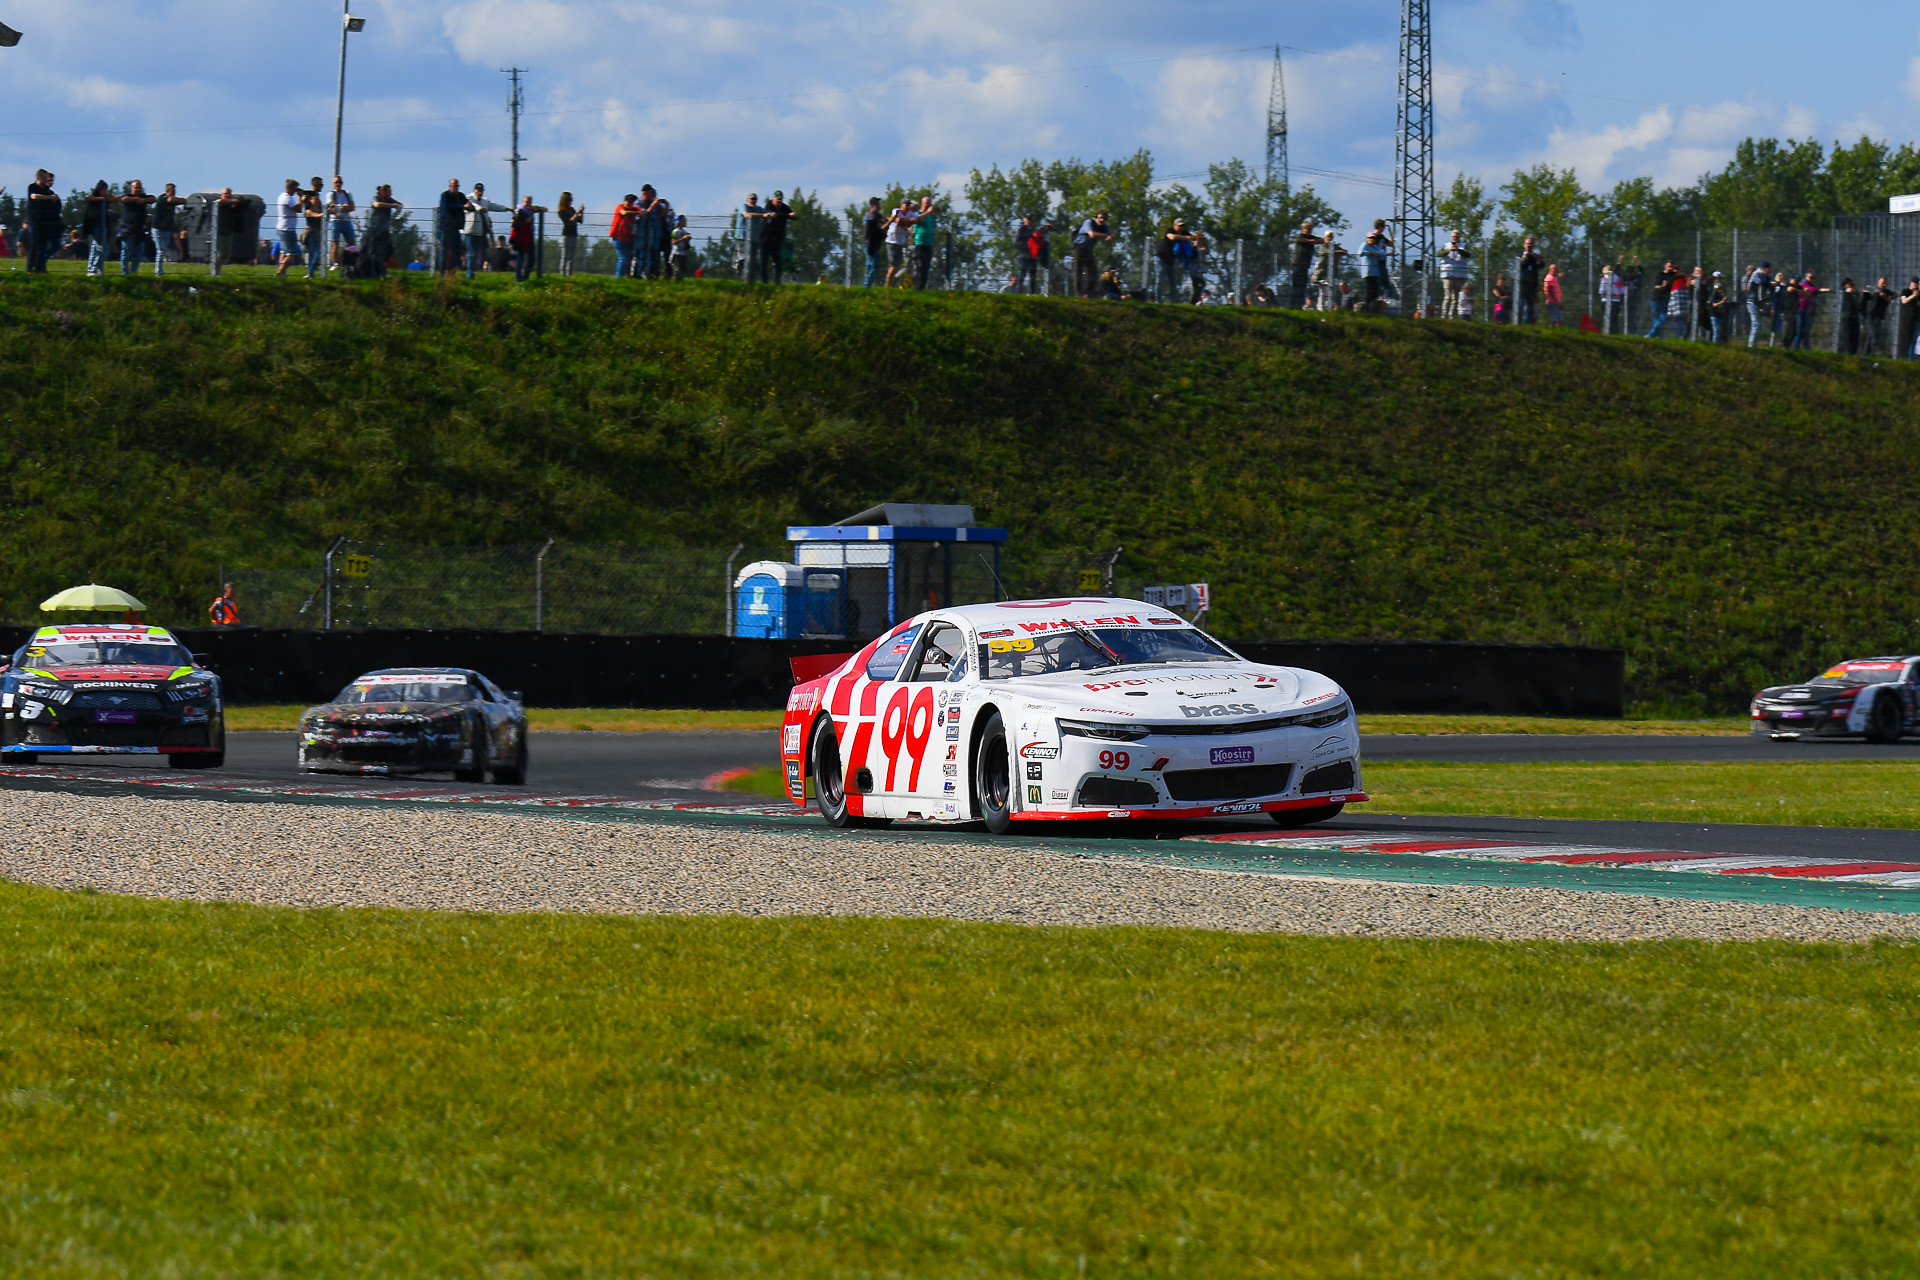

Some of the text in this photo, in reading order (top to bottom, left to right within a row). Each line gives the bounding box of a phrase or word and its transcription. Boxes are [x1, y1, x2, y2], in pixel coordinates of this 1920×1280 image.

[347, 558, 369, 573] T13
[1018, 615, 1141, 632] WHELEN
[63, 634, 142, 642] WHELEN
[988, 638, 1035, 653] 99
[26, 647, 47, 657] 3
[73, 681, 158, 690] ROCHINVEST
[19, 700, 45, 719] 3
[881, 686, 934, 792] 99
[1022, 747, 1058, 756] KENNOL
[1212, 748, 1252, 762] Hoosier
[1098, 750, 1130, 771] 99
